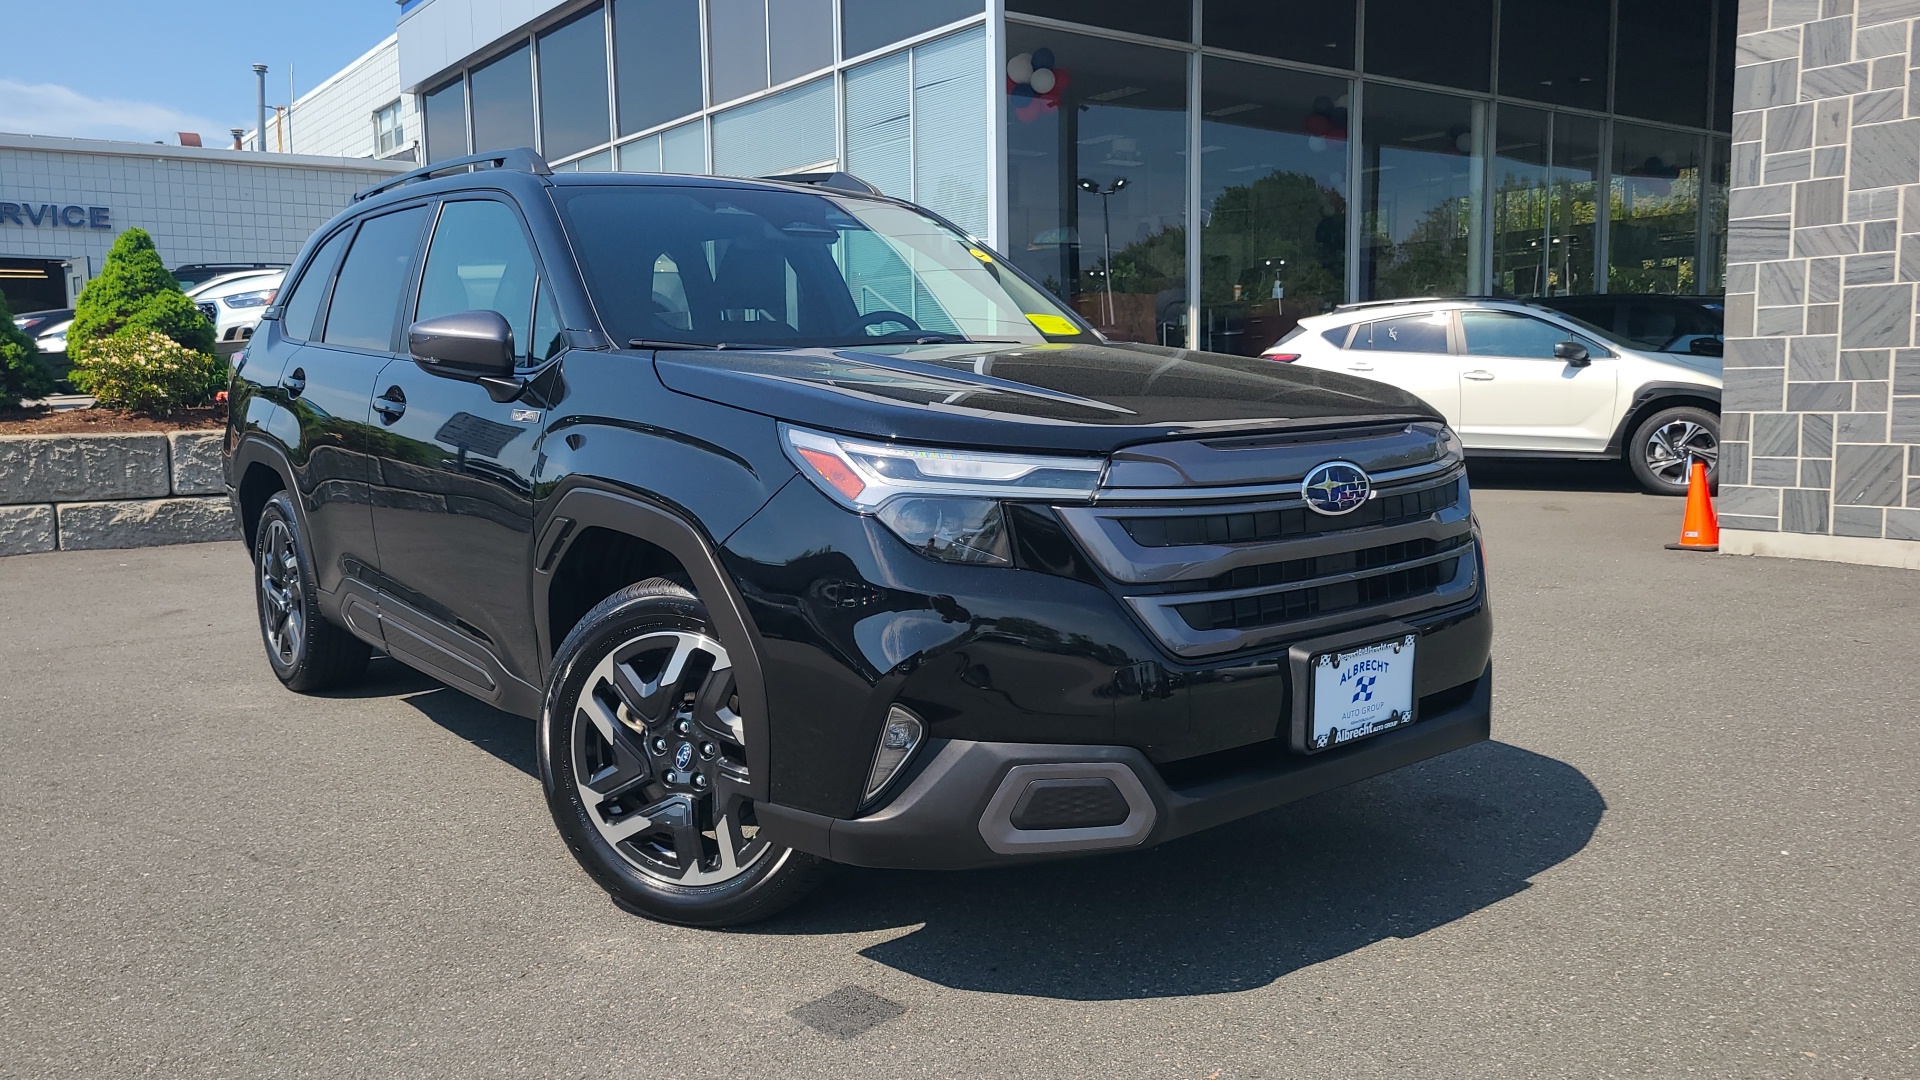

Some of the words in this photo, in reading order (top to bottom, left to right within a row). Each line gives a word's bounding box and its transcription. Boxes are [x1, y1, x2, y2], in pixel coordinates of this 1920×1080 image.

[0, 202, 111, 228] RVICE
[1339, 659, 1389, 686] ALBRECHT
[1342, 708, 1360, 720] AUTO
[1361, 701, 1385, 714] GROUP
[1335, 723, 1373, 743] Albrecht
[1373, 724, 1384, 732] AUTO
[1384, 720, 1399, 729] GROUP
